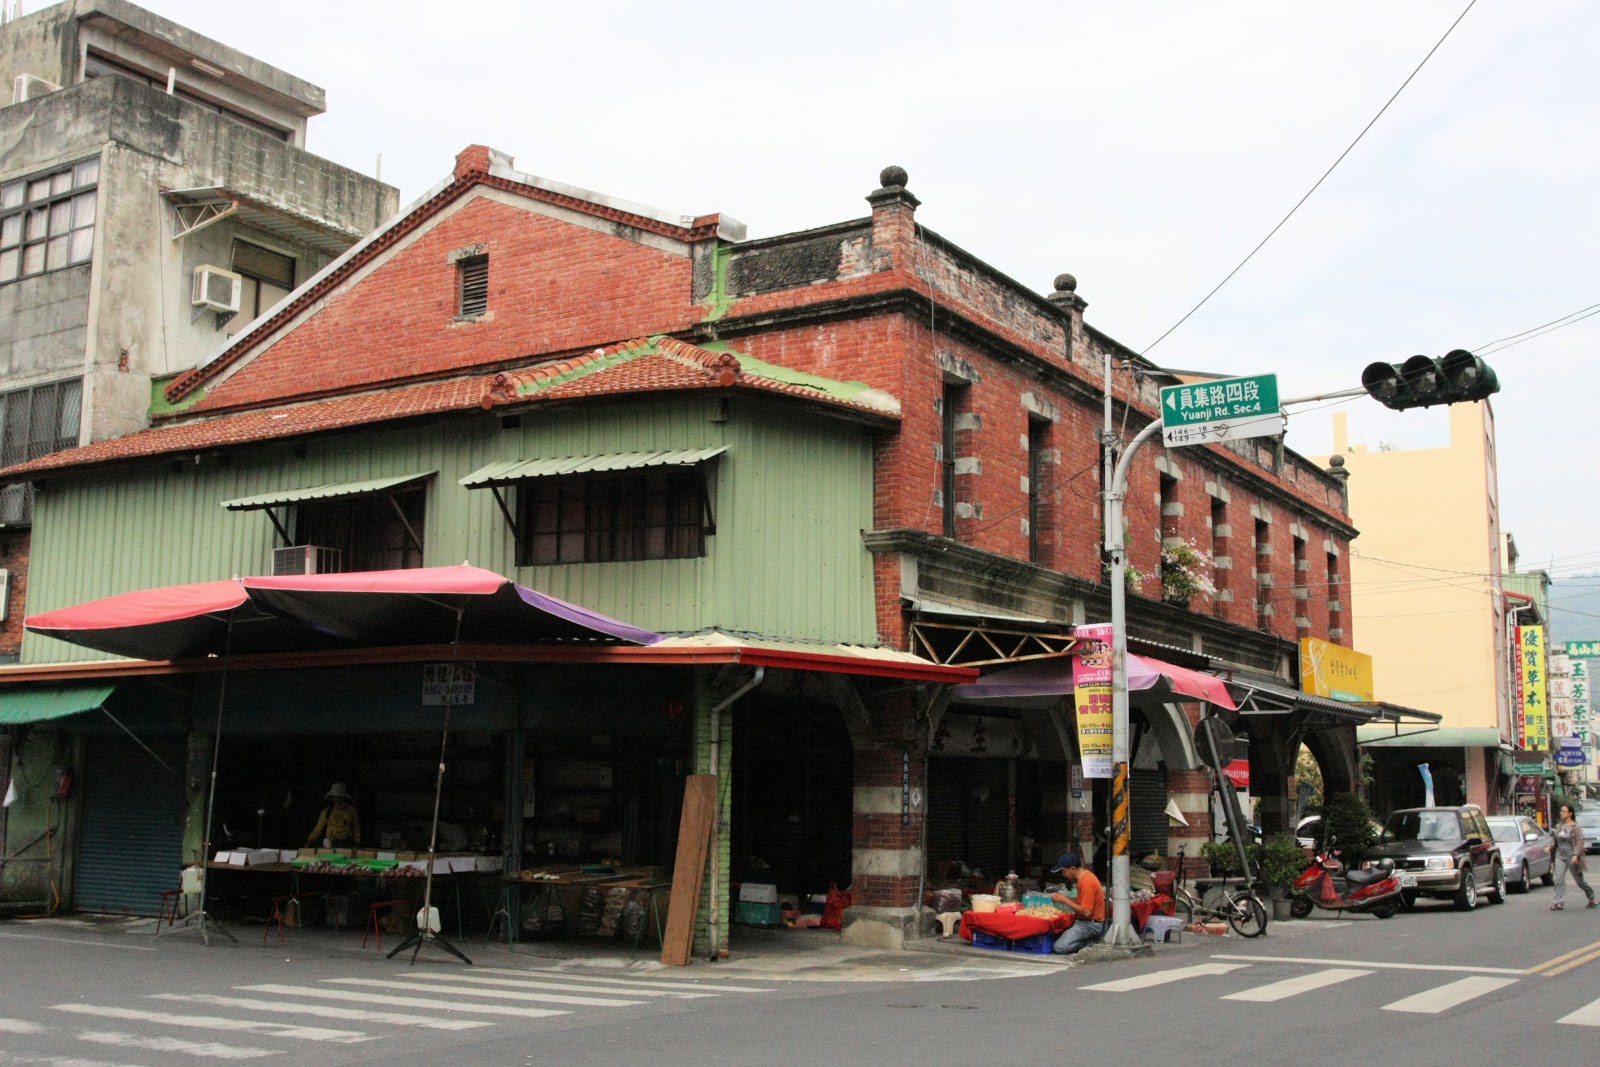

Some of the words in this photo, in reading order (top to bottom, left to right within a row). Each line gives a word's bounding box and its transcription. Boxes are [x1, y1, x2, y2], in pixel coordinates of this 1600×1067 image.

[1180, 381, 1260, 410] 員集路四段
[1181, 409, 1212, 421] Yuanji
[1214, 404, 1231, 417] Rd.
[1233, 402, 1261, 415] Sec.4
[1522, 629, 1541, 707] 優質草本
